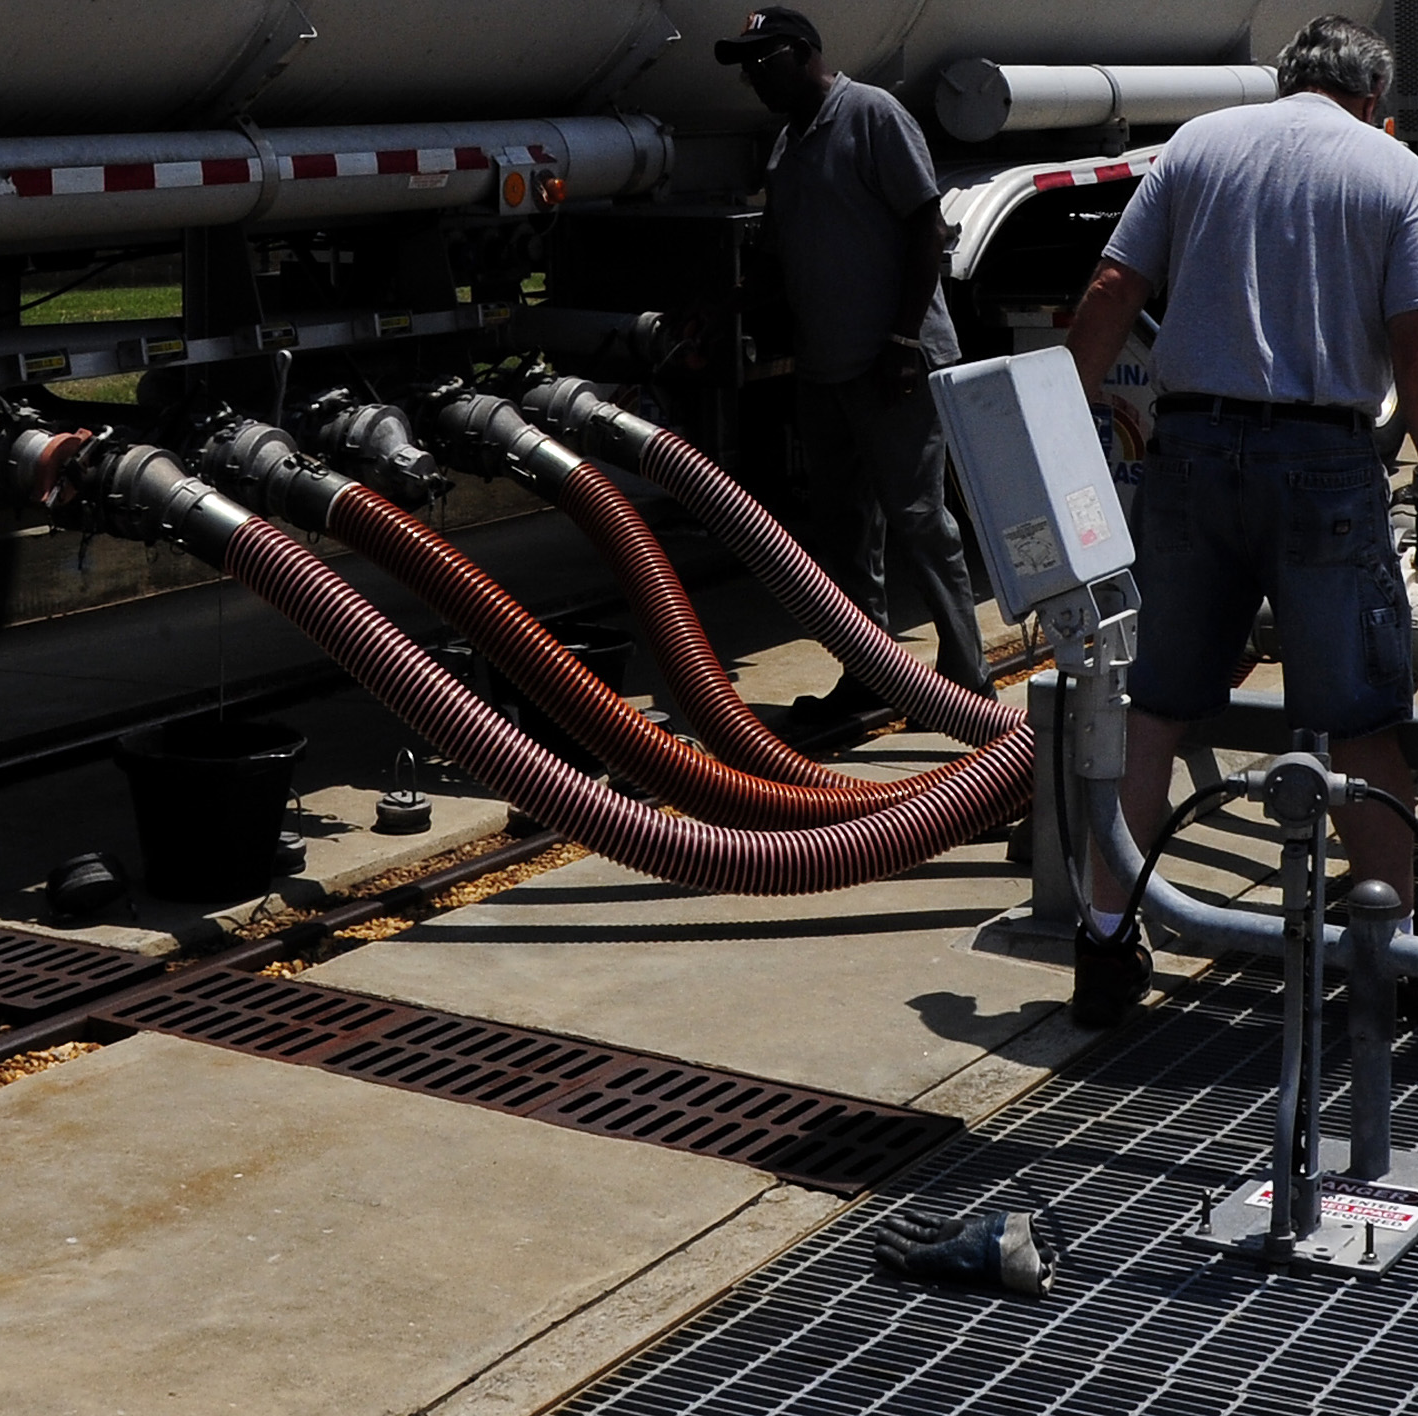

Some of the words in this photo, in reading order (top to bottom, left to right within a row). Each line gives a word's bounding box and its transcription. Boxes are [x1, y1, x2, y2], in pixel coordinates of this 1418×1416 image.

[1323, 1180, 1410, 1203] ANGER
[1348, 1198, 1400, 1211] ENTER
[1352, 1206, 1407, 1221] SPACE
